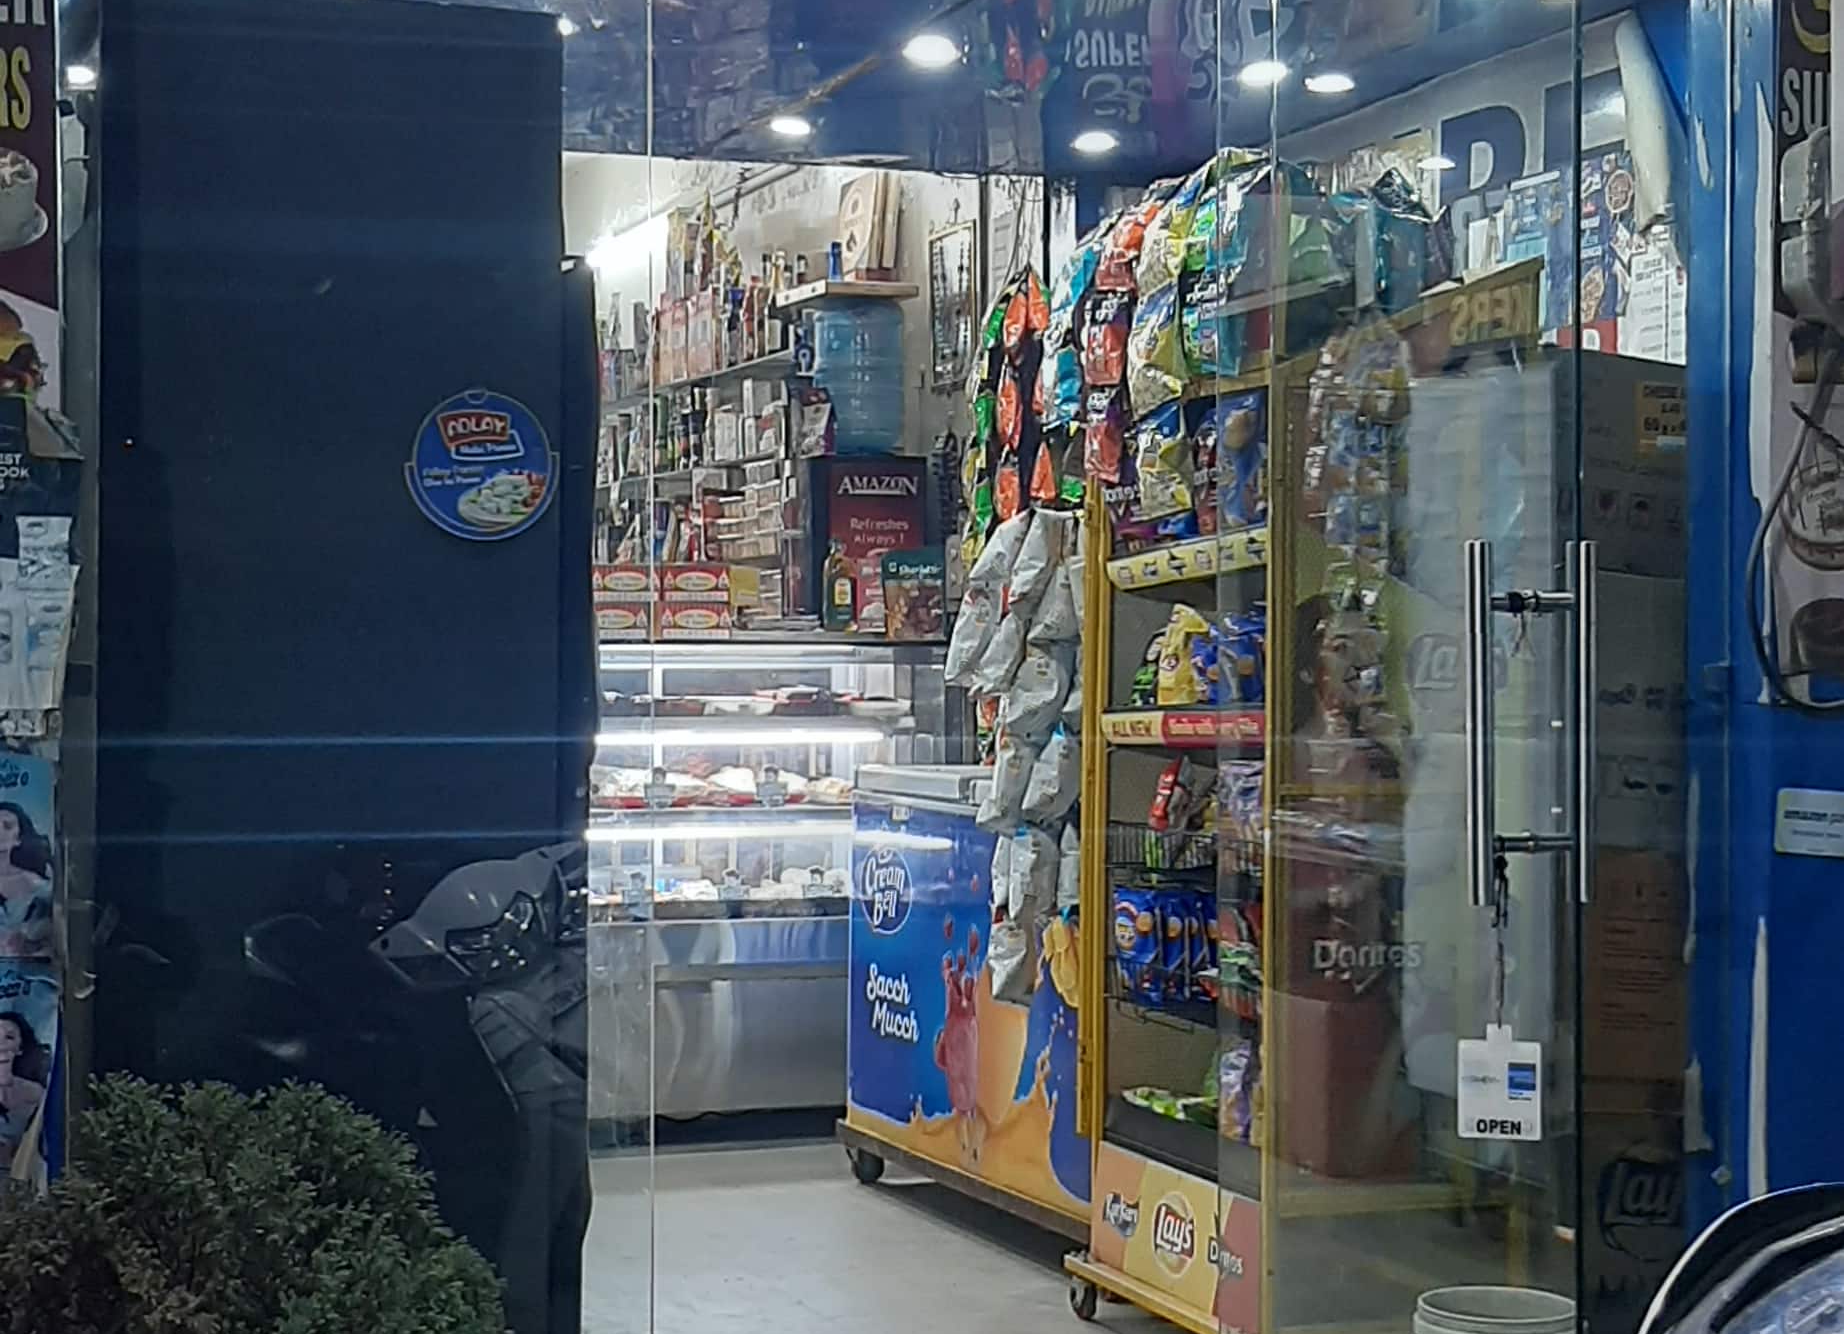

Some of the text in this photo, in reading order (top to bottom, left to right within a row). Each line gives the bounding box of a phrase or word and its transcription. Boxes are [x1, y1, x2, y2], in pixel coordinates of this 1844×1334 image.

[1780, 67, 1831, 136] SU
[837, 475, 919, 496] AMAZON
[864, 857, 905, 895] Cream
[873, 888, 898, 927] Bell
[866, 963, 911, 1005] Sacch
[872, 999, 920, 1043] Mucch
[1476, 1118, 1522, 1135] OPEN
